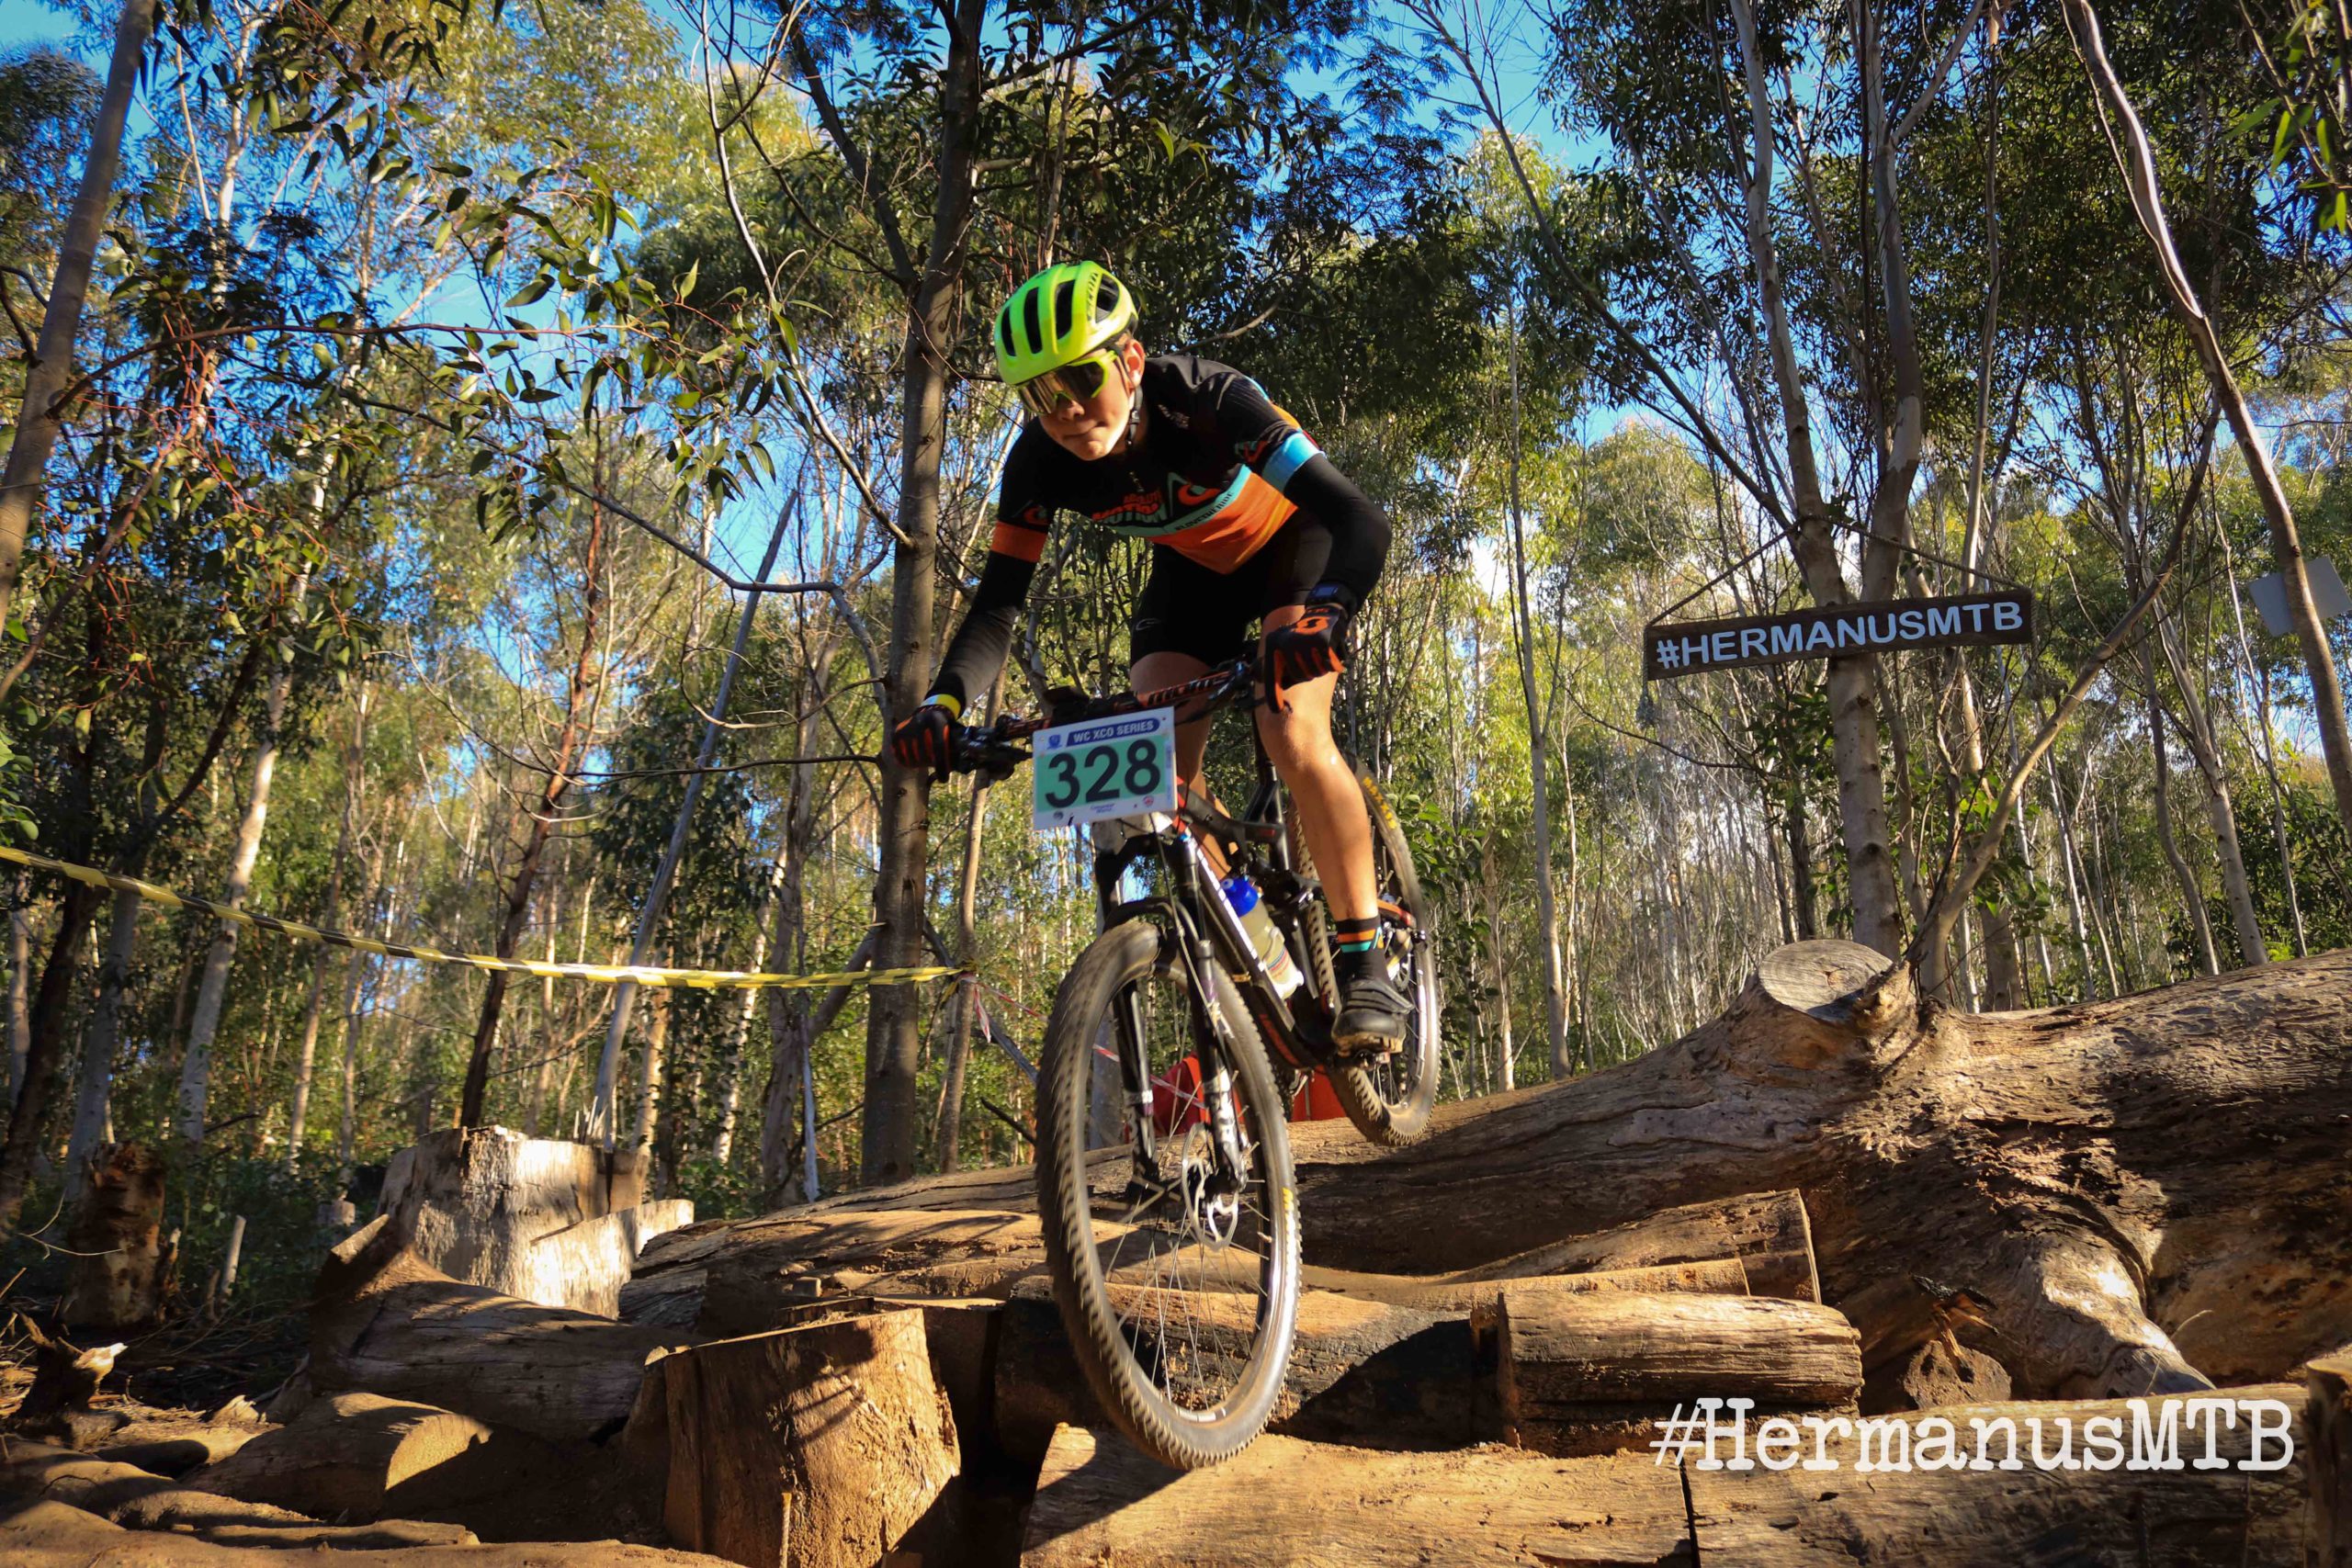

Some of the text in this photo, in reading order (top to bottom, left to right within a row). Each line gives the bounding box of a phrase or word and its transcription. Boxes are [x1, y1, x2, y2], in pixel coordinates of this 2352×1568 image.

[1656, 601, 2024, 670] #HERMANUSMTB
[1073, 719, 1155, 743] WC XCO SERIES
[1045, 739, 1161, 809] 328
